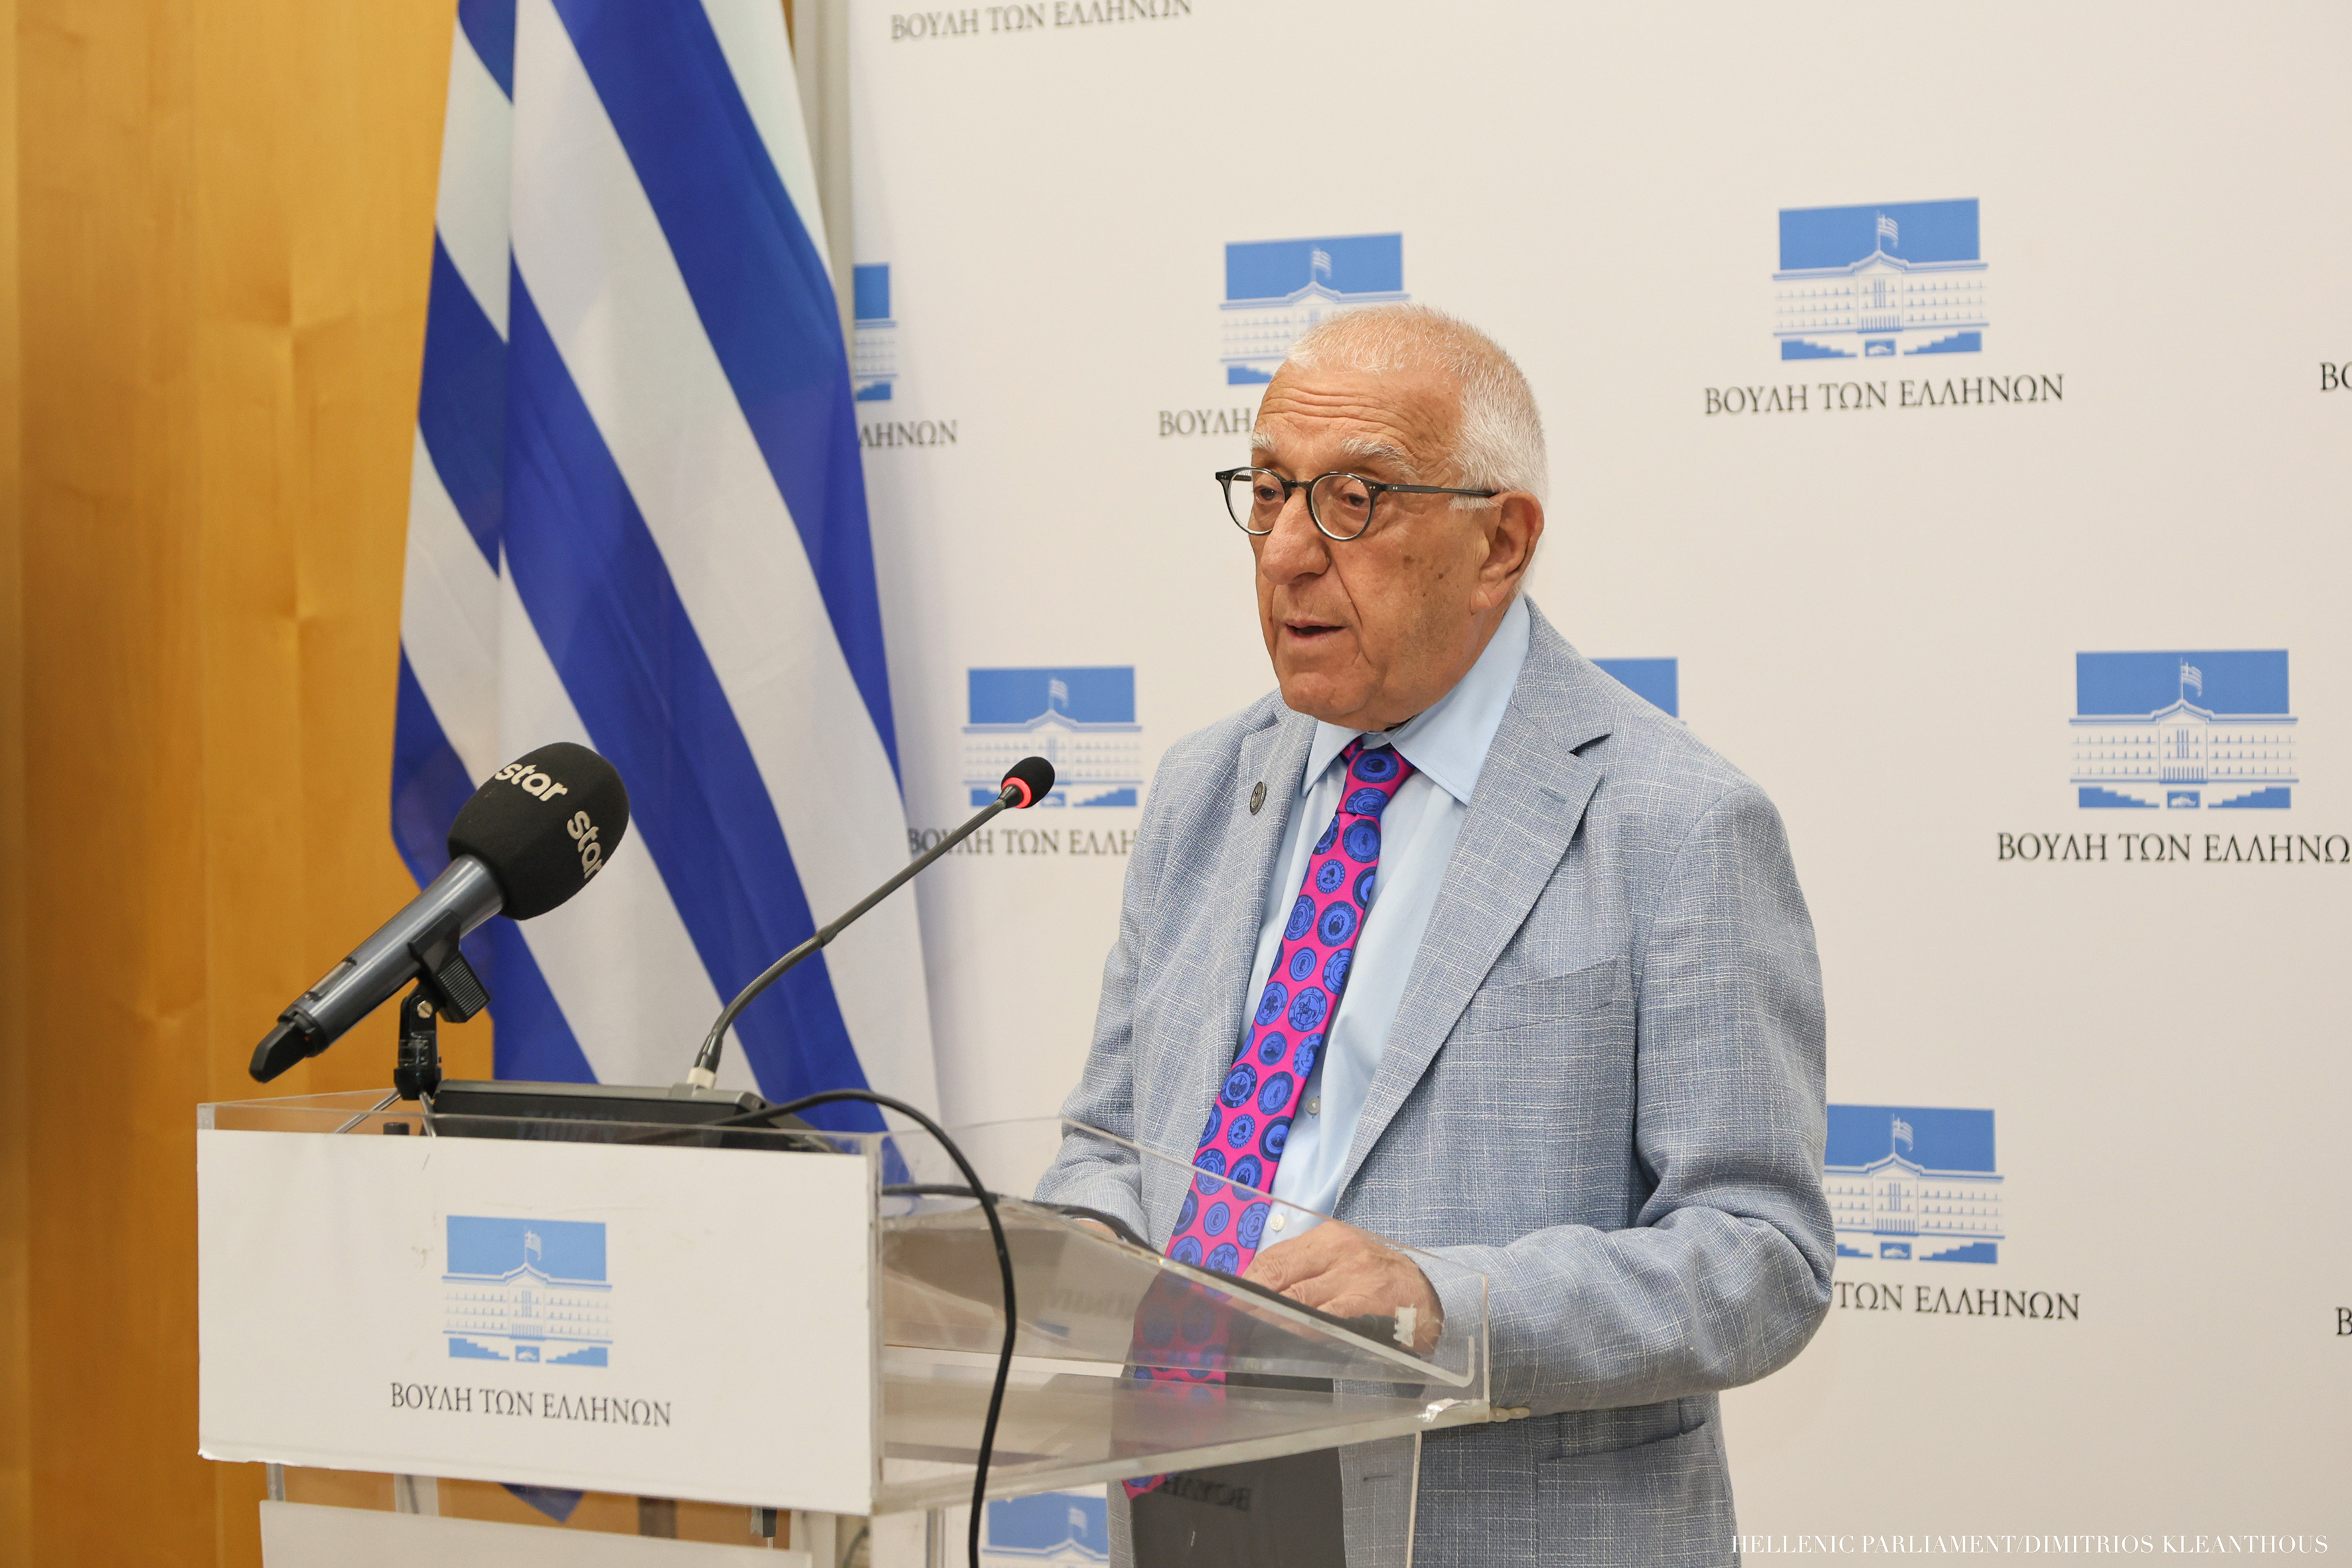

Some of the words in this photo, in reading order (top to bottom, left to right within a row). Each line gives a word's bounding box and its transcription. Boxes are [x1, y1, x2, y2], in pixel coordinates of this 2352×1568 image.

[891, 8, 979, 41] ΒΟΥΛΗ
[986, 4, 1046, 33] ΤΩΝ
[1704, 383, 1809, 416] ΒΟΥΛΗ
[1818, 380, 1887, 412] ΤΩΝ
[1899, 373, 2064, 408] ΕΛΛΗΝΩΝ
[1158, 407, 1251, 436] ΒΟΥΛΗ
[494, 762, 568, 802] star
[1000, 828, 1060, 856] ΤΩΝ
[1996, 832, 2109, 862] ΒΟΥΛΗ
[2117, 832, 2192, 863] ΤΩΝ
[2203, 833, 2351, 865] ΕΛΛΗΝΩ
[1834, 1280, 1904, 1311] ΤΩΝ
[1915, 1285, 2081, 1320] ΕΛΛΗΝΩΝ
[390, 1381, 473, 1413] ΒΟΥΛΗ
[478, 1388, 534, 1417] ΤΩΝ
[542, 1393, 671, 1427] ΕΛΛΗΝΩΝ
